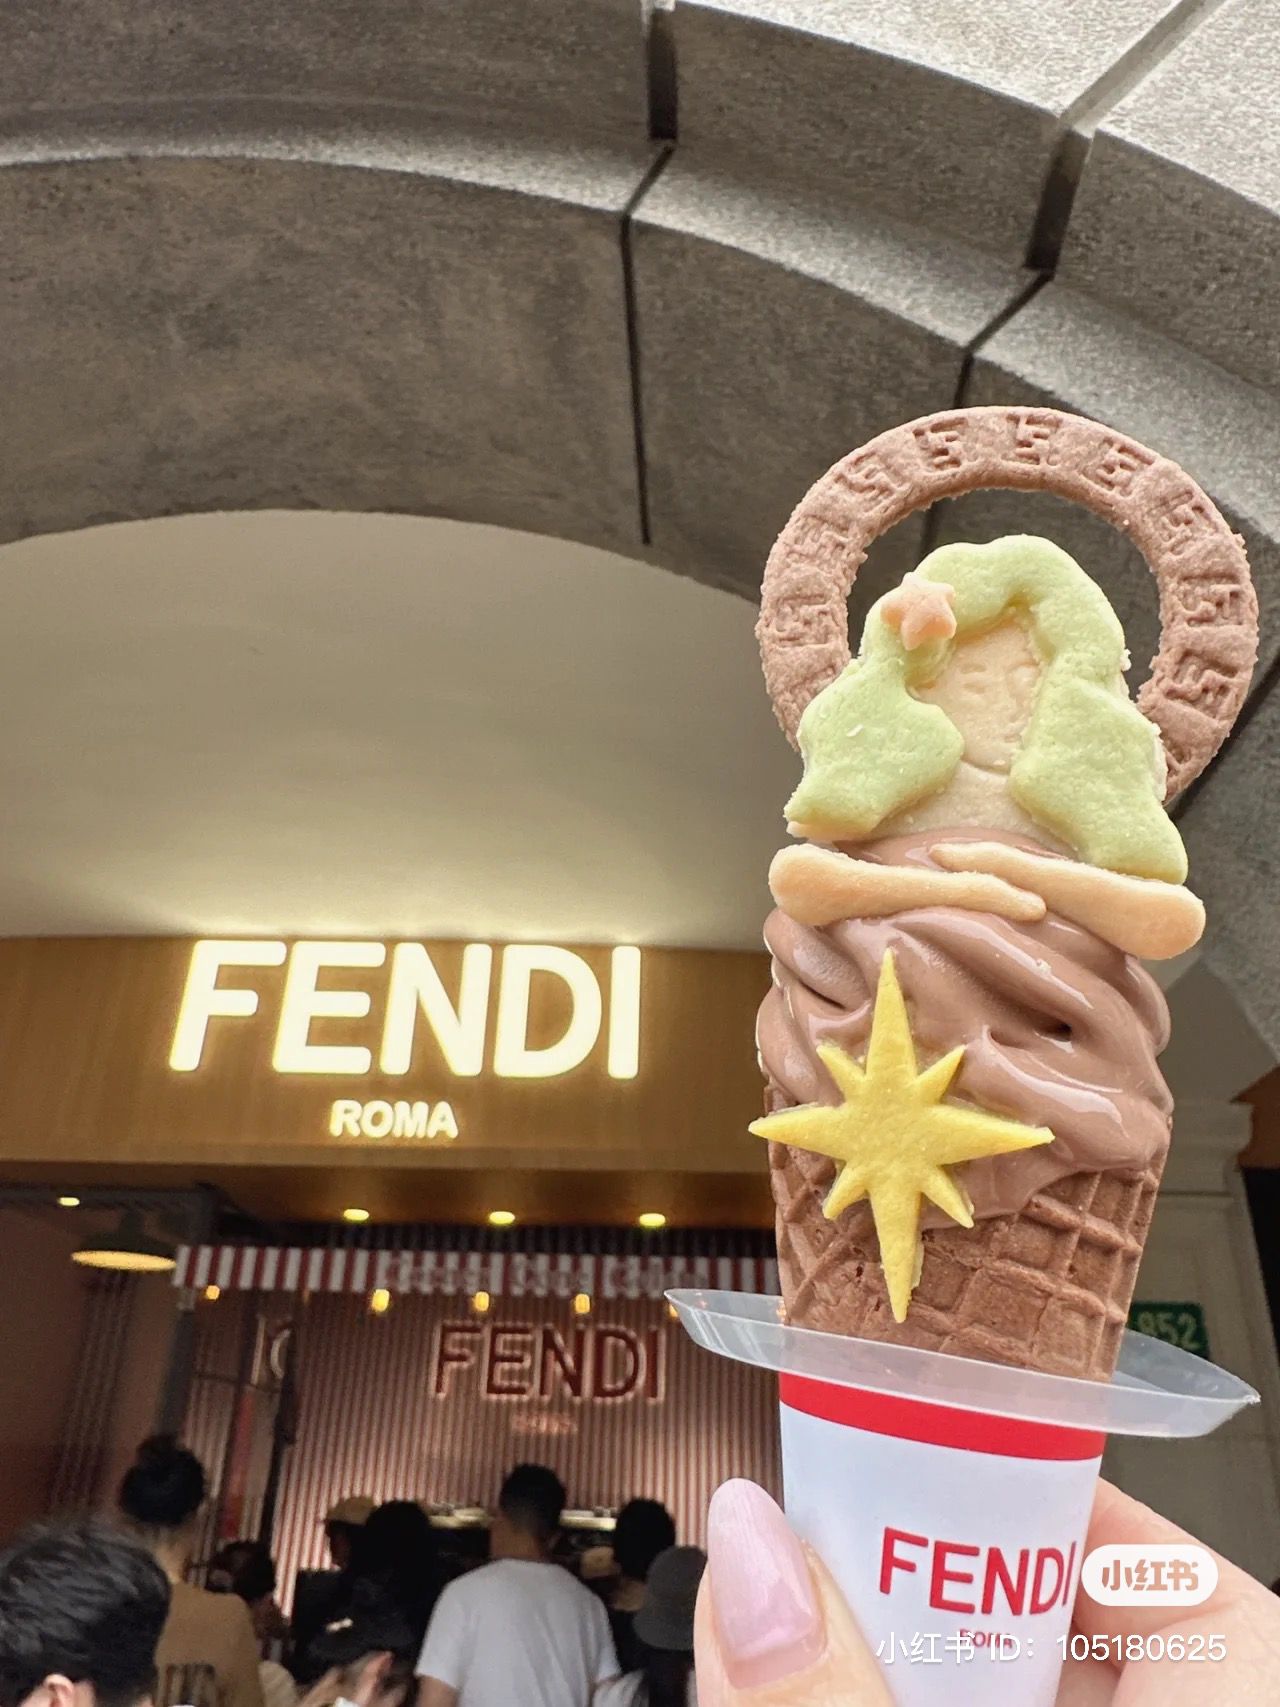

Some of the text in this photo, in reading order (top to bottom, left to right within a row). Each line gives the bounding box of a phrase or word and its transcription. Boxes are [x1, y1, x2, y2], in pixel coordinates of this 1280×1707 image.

[169, 939, 641, 1079] FENDI
[329, 1099, 459, 1139] ROMA
[430, 1320, 666, 1403] FENDI
[879, 1526, 1077, 1617] FENDI
